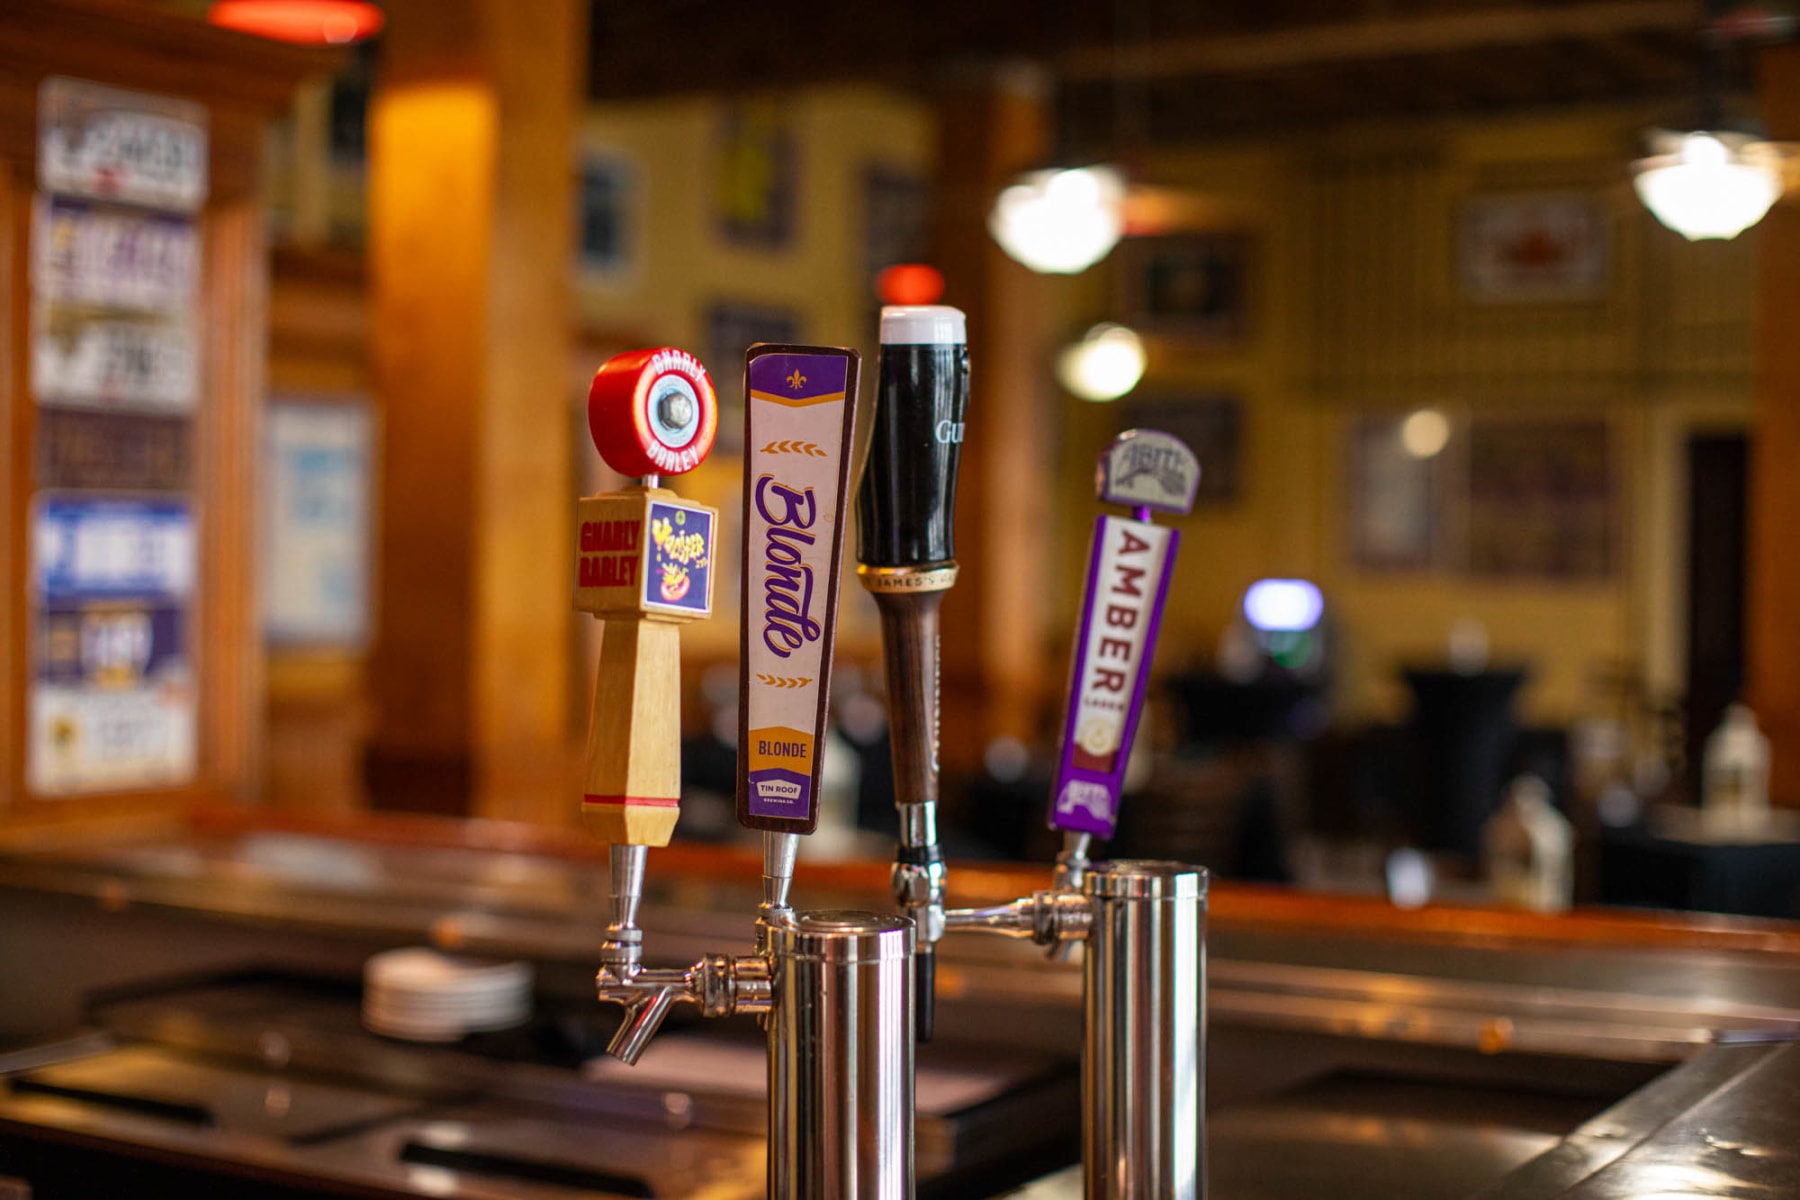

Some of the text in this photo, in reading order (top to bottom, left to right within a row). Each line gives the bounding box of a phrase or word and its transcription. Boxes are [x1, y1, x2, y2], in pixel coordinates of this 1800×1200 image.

[652, 349, 706, 382] GNARLY
[646, 440, 699, 473] BARLEY
[581, 520, 641, 553] GNARLY
[578, 555, 639, 588] BARLEY
[755, 473, 821, 659] Blonde
[1091, 529, 1151, 694] AMBER
[758, 740, 807, 758] BLONDE
[760, 784, 798, 794] TIN ROOF
